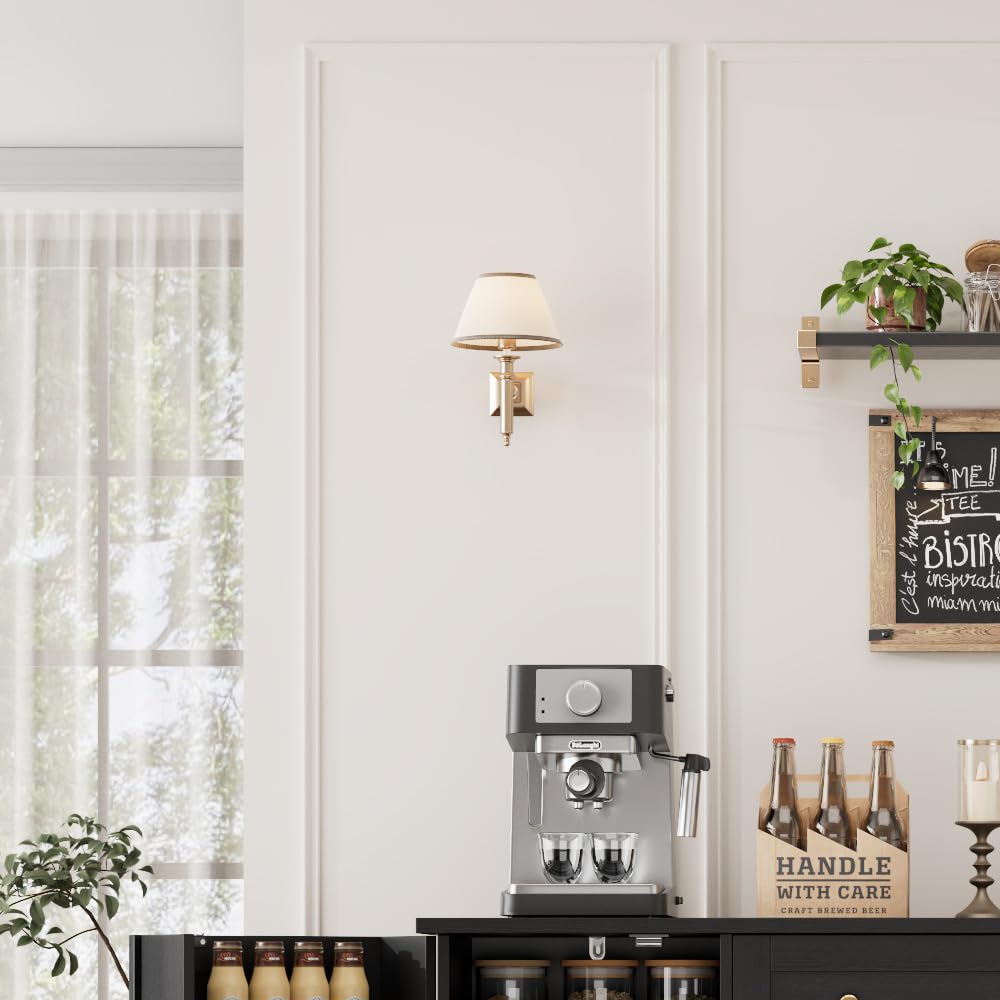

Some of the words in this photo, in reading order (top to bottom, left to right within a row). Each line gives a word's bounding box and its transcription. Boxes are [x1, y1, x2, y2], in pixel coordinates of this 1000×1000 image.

[776, 857, 891, 876] HANDLE
[777, 886, 830, 900] WITH
[838, 886, 891, 900] CARE
